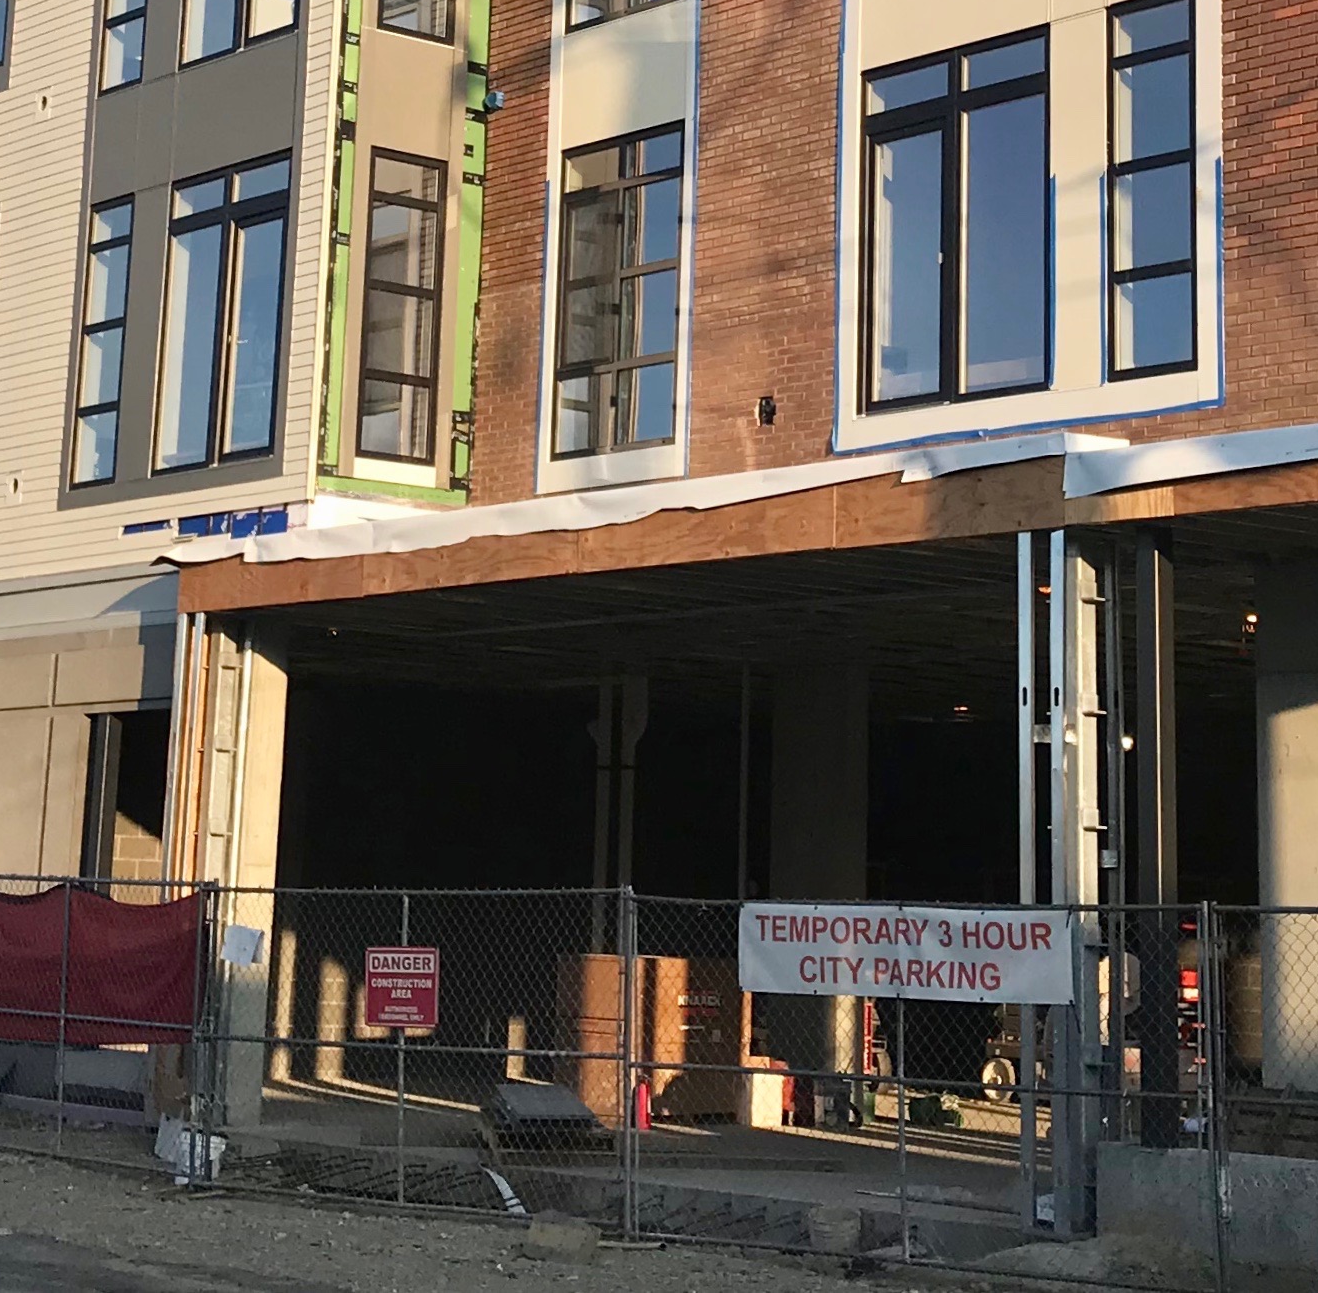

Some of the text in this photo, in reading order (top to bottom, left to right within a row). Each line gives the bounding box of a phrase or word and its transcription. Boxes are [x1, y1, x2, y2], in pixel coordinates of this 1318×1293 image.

[755, 914, 1053, 951] TEMPORARY 3 HOUR
[371, 956, 432, 971] DANGER
[799, 956, 1002, 992] CITY PARKING
[371, 978, 433, 989] CONSTRUCTION
[391, 989, 412, 999] AREA
